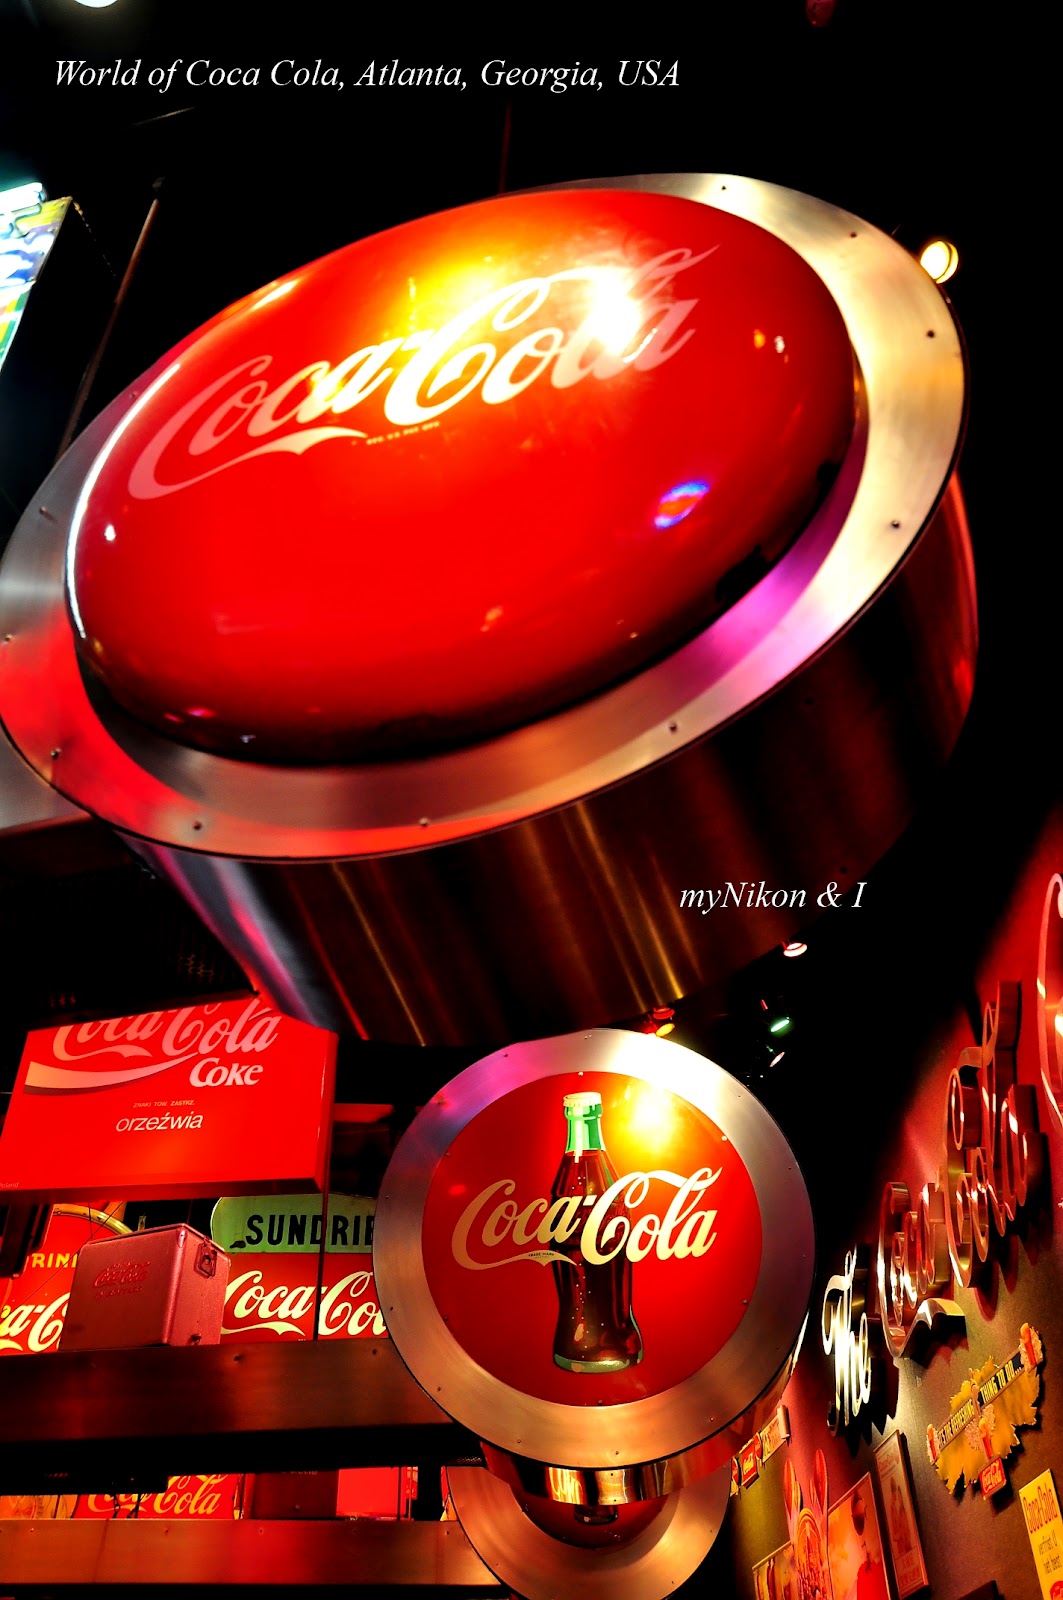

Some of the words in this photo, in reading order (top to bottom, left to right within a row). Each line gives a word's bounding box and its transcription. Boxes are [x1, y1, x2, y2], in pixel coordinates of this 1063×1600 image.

[128, 244, 720, 500] Coca-Cola
[189, 1057, 264, 1088] Coke
[115, 1110, 204, 1133] orzeźwia
[245, 1214, 375, 1246] SUNDRIE
[451, 1167, 723, 1271] Coca-Cola
[996, 1368, 1006, 1390] TO
